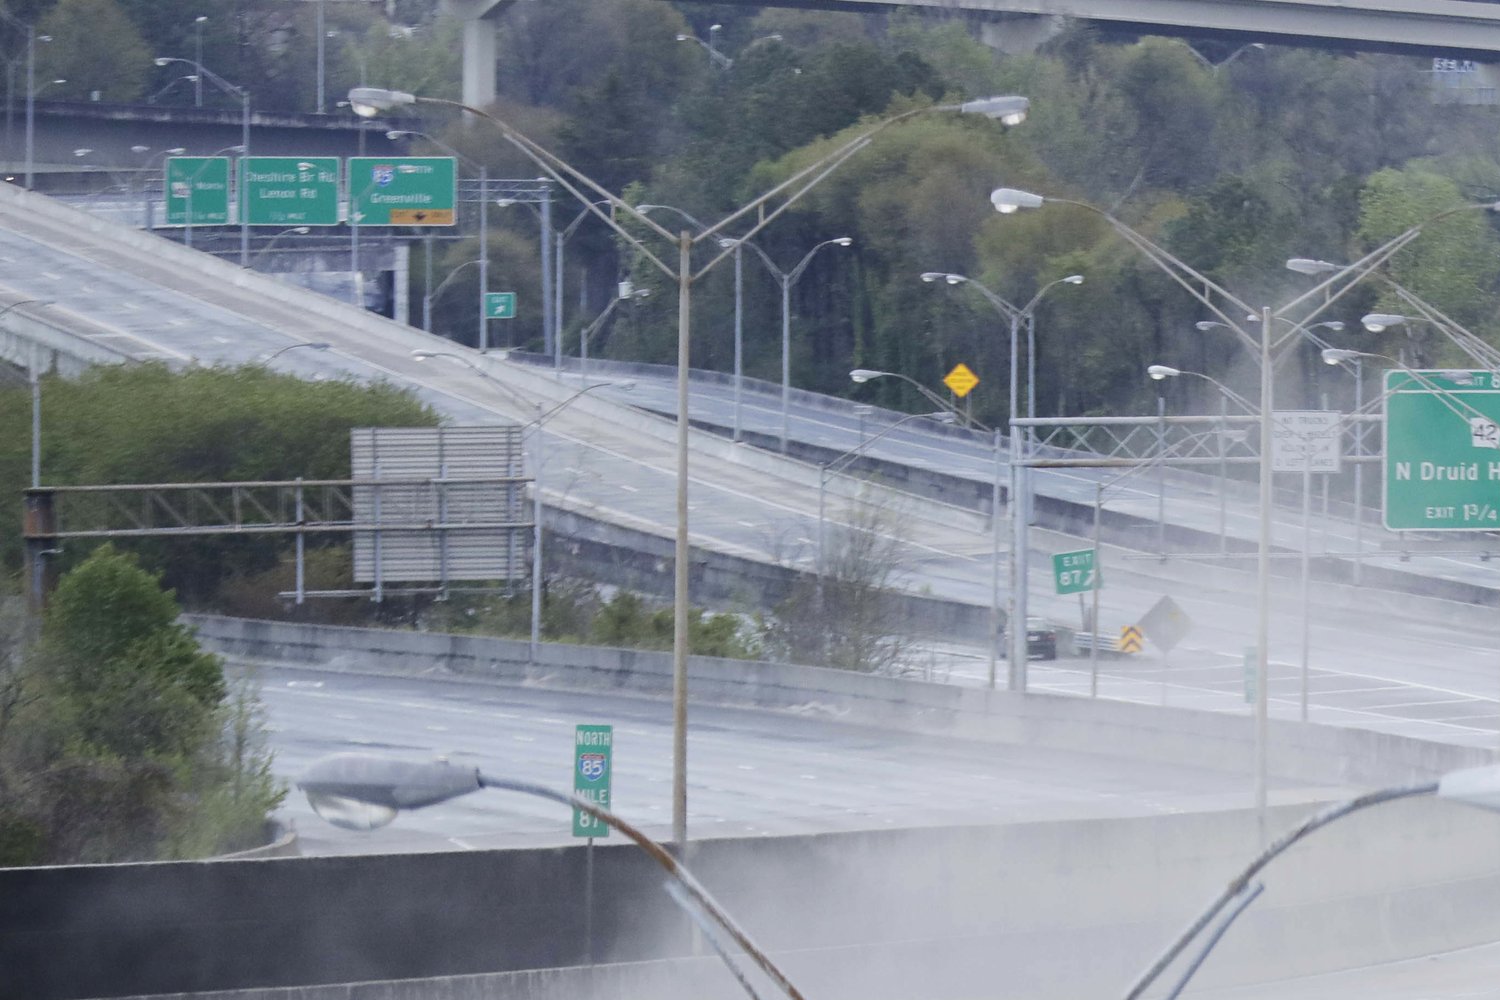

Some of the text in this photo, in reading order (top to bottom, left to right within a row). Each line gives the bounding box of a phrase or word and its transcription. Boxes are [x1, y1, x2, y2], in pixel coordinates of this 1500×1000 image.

[370, 193, 432, 204] Greenville
[1473, 424, 1497, 441] 42
[1396, 462, 1411, 481] N
[1421, 462, 1479, 481] Druid
[1425, 507, 1455, 519] EXIT
[1063, 553, 1091, 567] EXIT
[1060, 570, 1082, 586] 87
[576, 730, 610, 746] NORTH
[582, 760, 602, 775] 85
[576, 789, 608, 804] MILE
